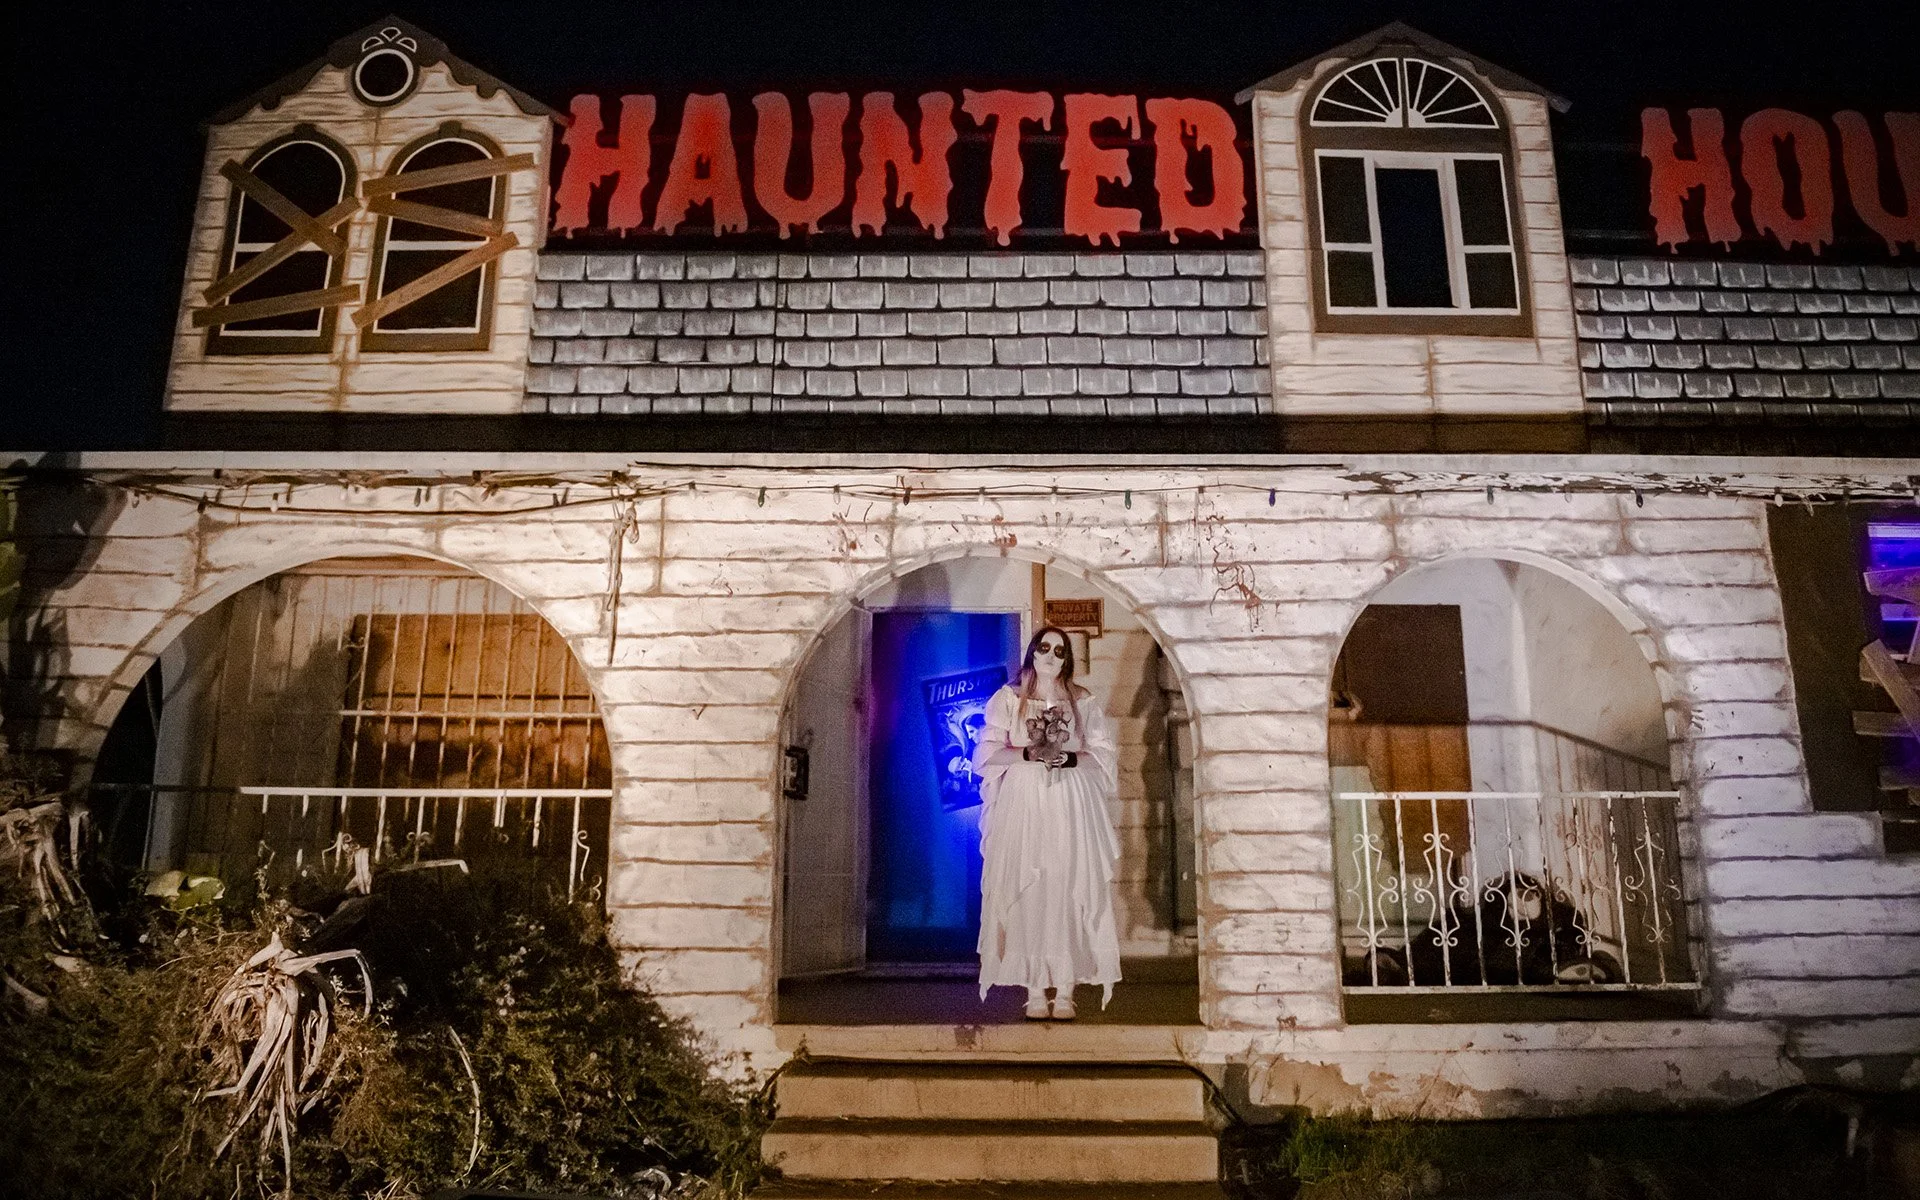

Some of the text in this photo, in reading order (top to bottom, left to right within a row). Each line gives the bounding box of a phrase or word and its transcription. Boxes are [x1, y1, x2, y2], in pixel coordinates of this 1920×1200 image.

[552, 89, 1247, 246] HAUNTED
[1052, 602, 1093, 612] PRIVATE
[1048, 612, 1097, 622] PROPERTY
